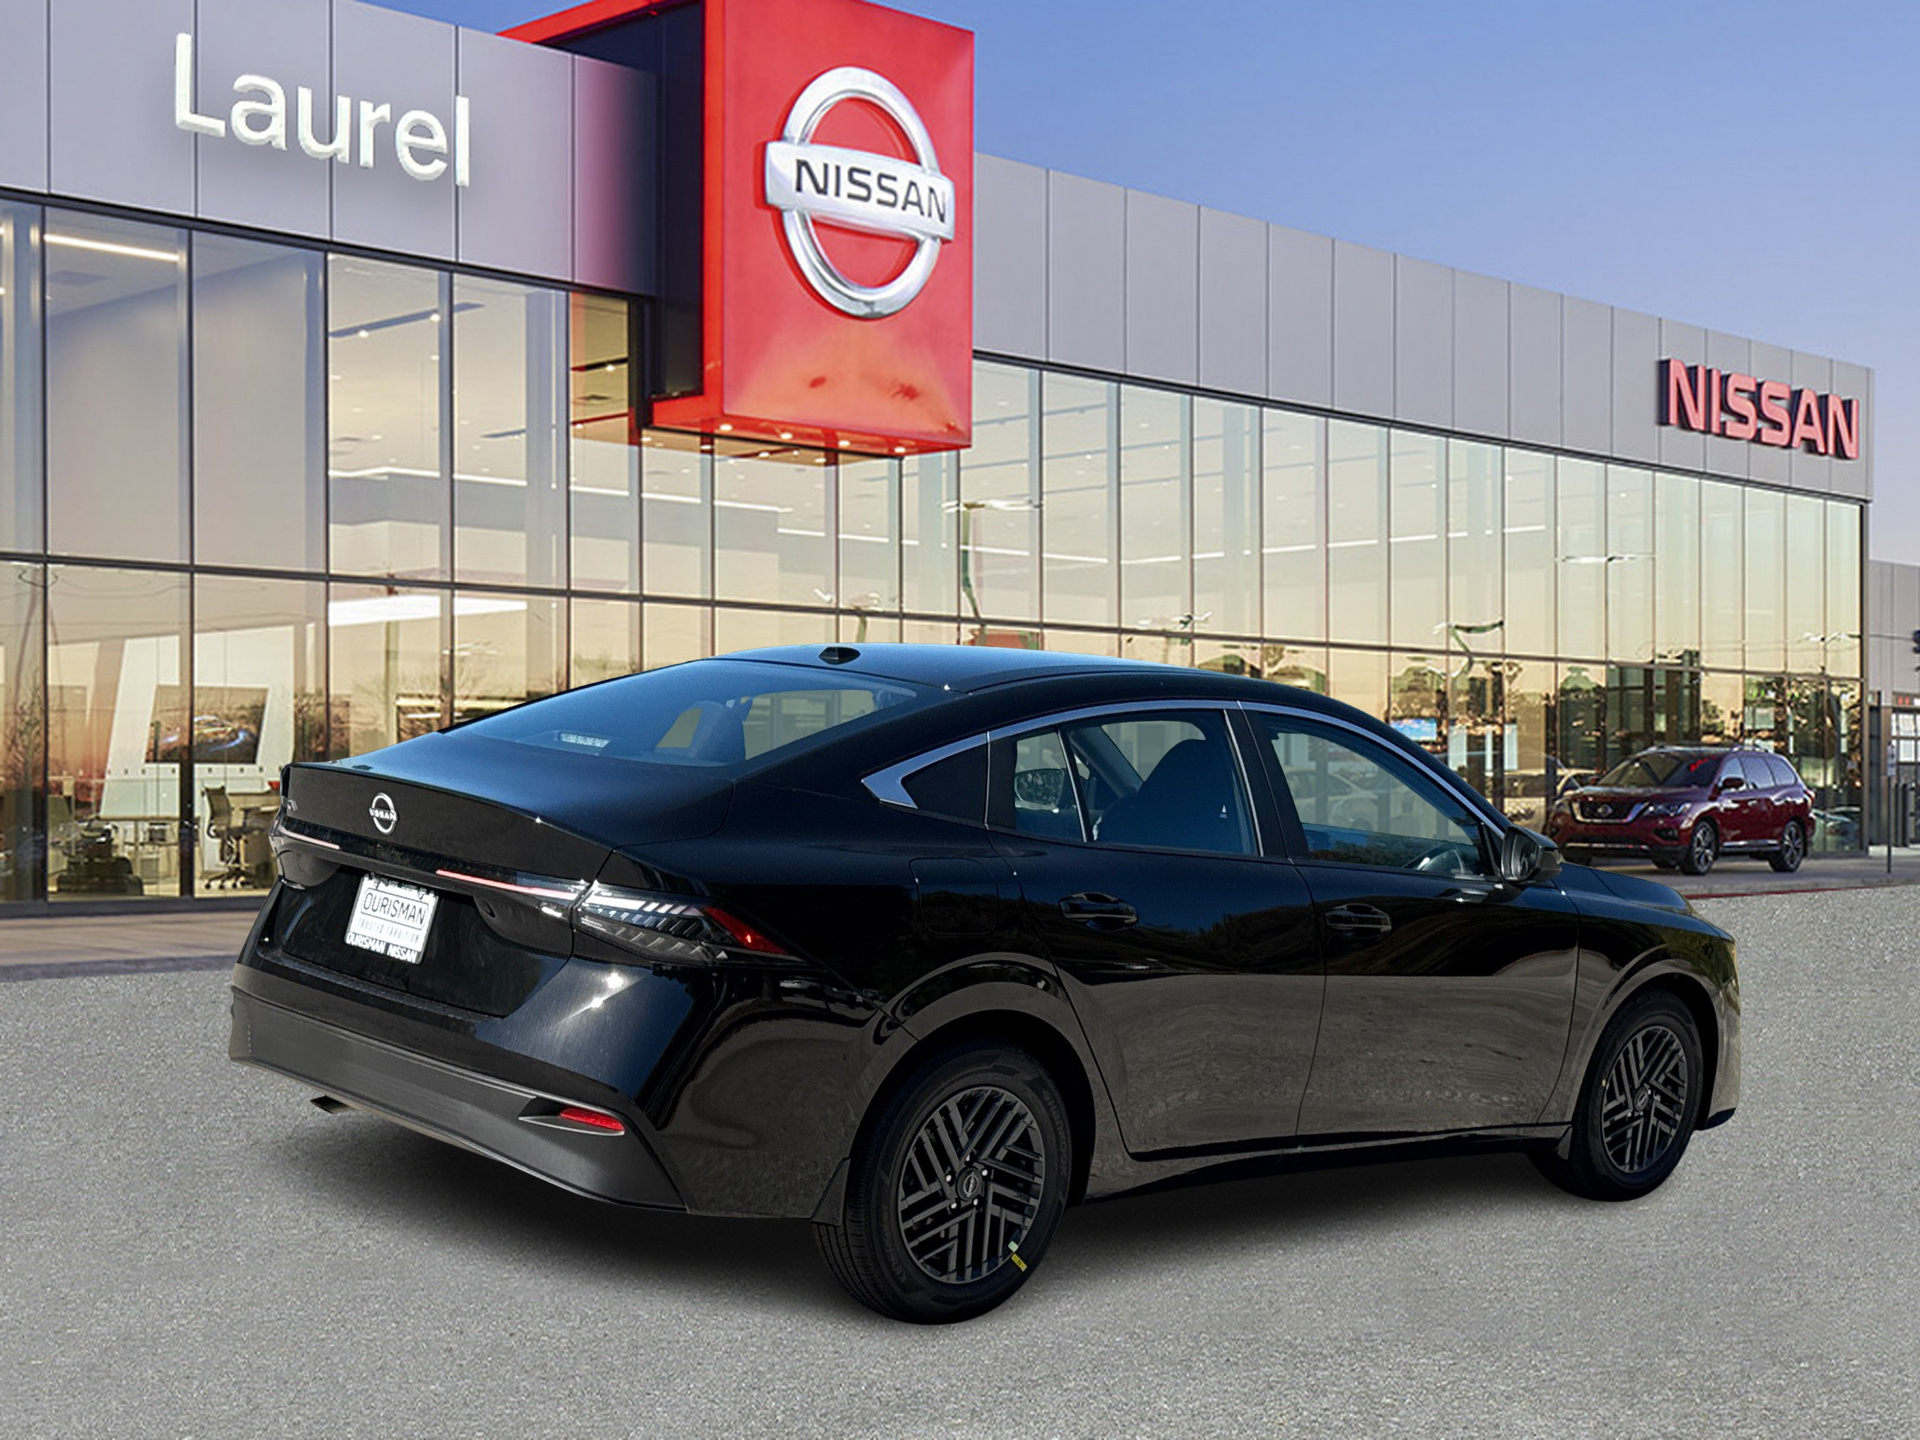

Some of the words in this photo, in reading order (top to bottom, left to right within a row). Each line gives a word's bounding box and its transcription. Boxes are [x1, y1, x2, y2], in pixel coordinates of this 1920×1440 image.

[175, 32, 470, 187] Laurel
[795, 158, 947, 224] NISSAN
[1667, 358, 1860, 460] NISSAN
[363, 892, 426, 925] OURISMAN
[345, 932, 387, 954] OURISMAN
[386, 943, 418, 963] NISSAN
